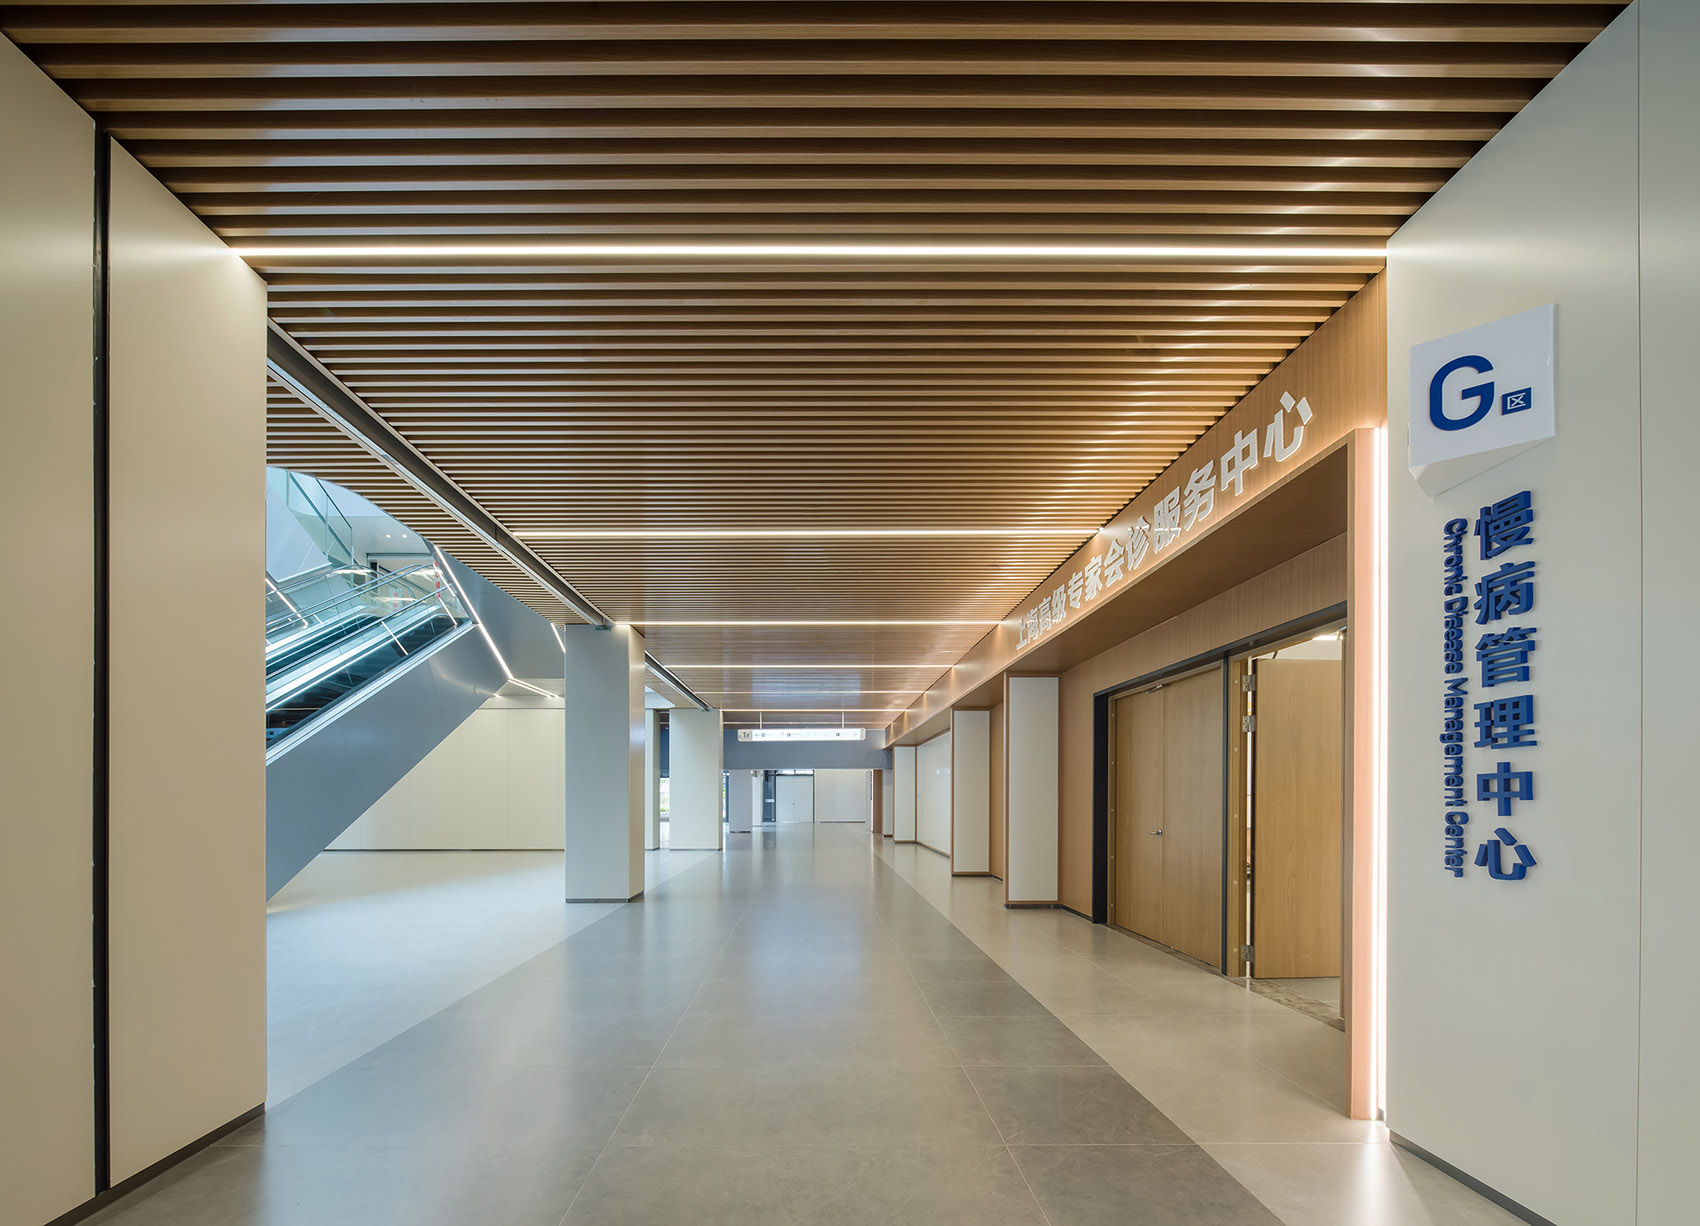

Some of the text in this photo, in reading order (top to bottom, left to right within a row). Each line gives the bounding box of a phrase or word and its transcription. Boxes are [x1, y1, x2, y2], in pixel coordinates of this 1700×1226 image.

[1015, 391, 1313, 651] 上海高级专家会诊服务中心
[1429, 355, 1495, 431] G
[1440, 518, 1469, 878] Chronic Disease Management Center
[1474, 490, 1537, 880] 慢病管理中心
